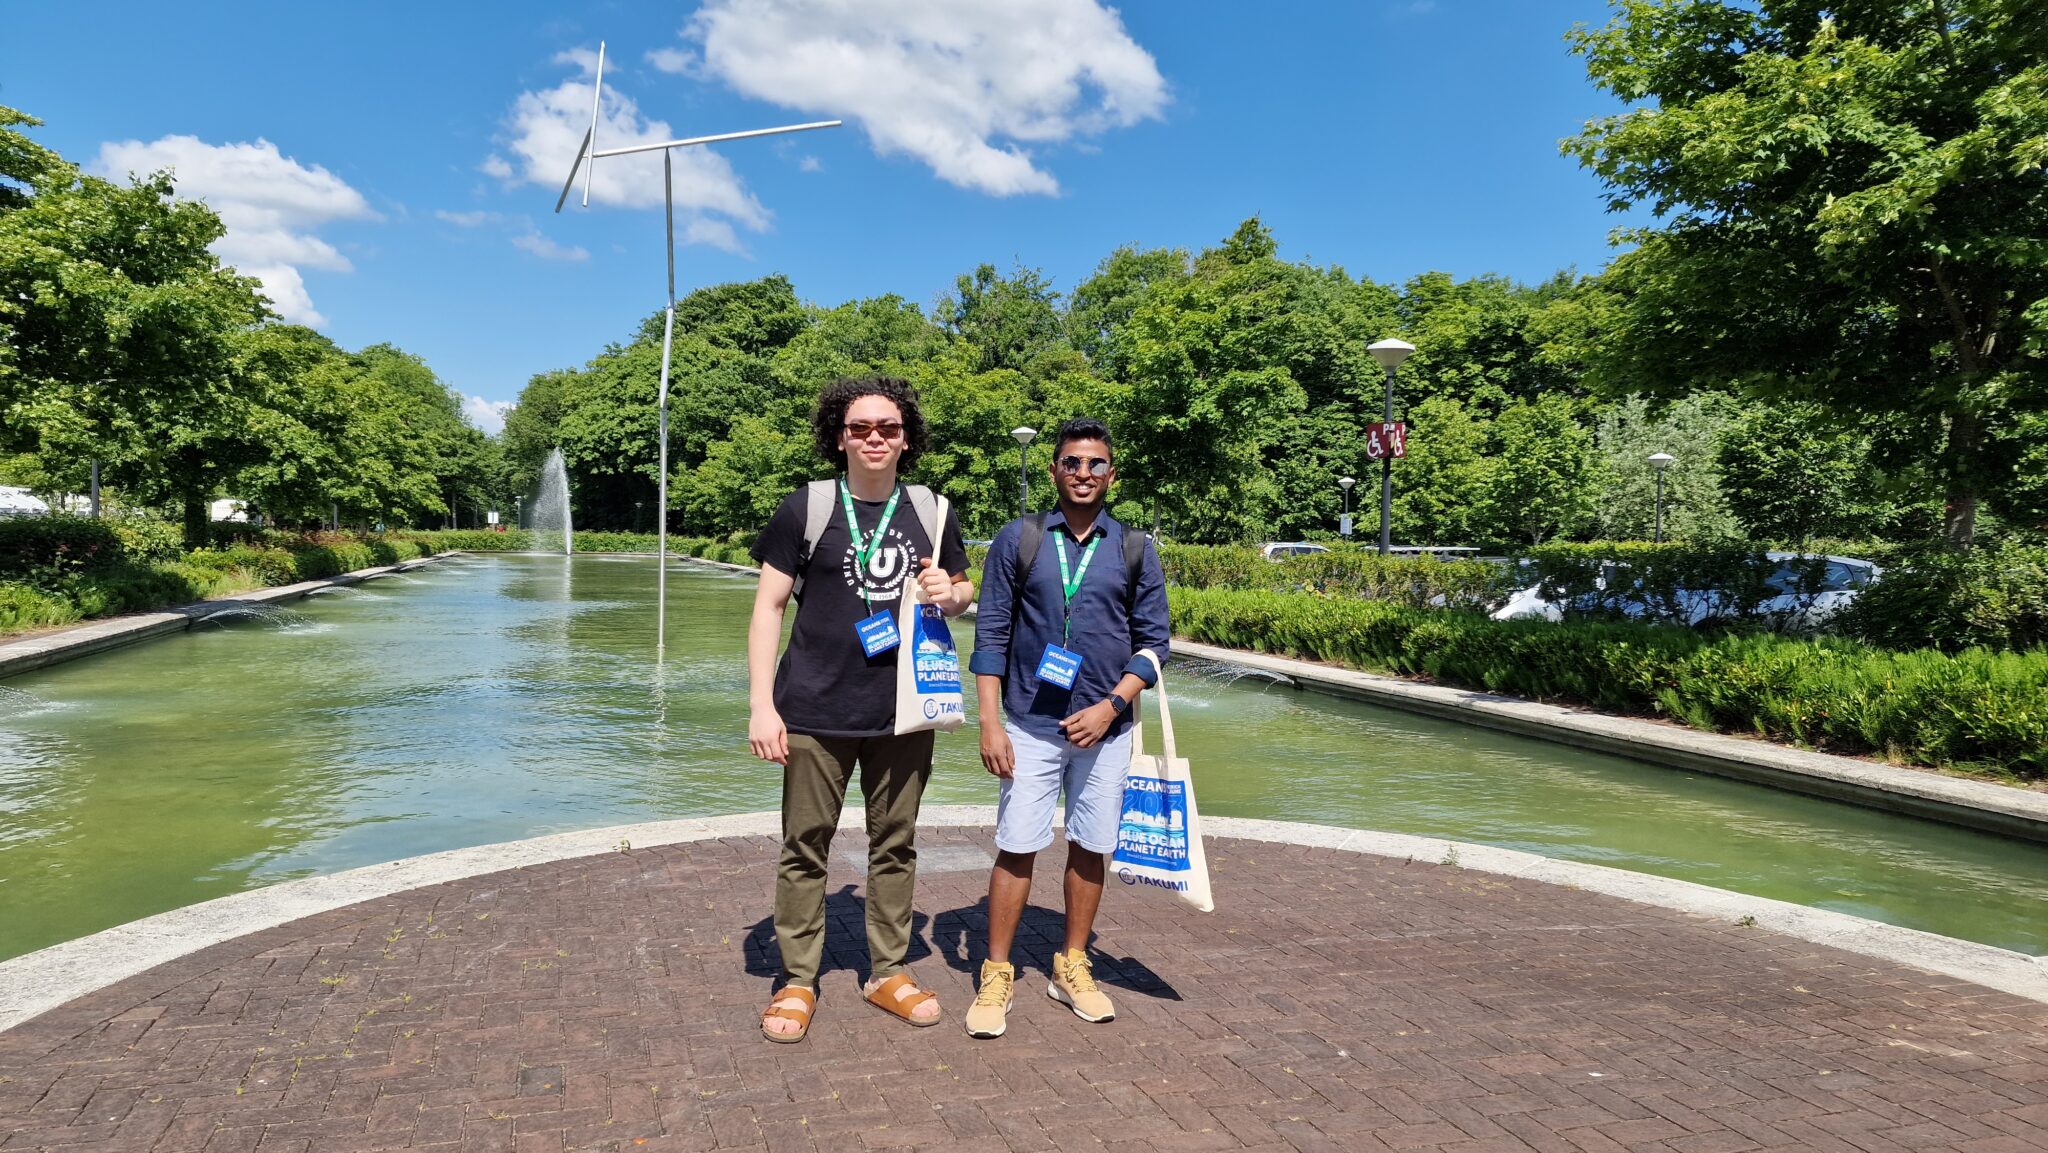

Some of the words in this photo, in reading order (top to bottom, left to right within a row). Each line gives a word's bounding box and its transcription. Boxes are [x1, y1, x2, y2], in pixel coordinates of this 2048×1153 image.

[889, 528, 903, 540] DE
[869, 547, 898, 578] U
[918, 671, 946, 682] PLANE
[1119, 830, 1147, 844] BLUE
[1119, 841, 1156, 855] PLANET
[1136, 875, 1188, 892] TAKUMI
